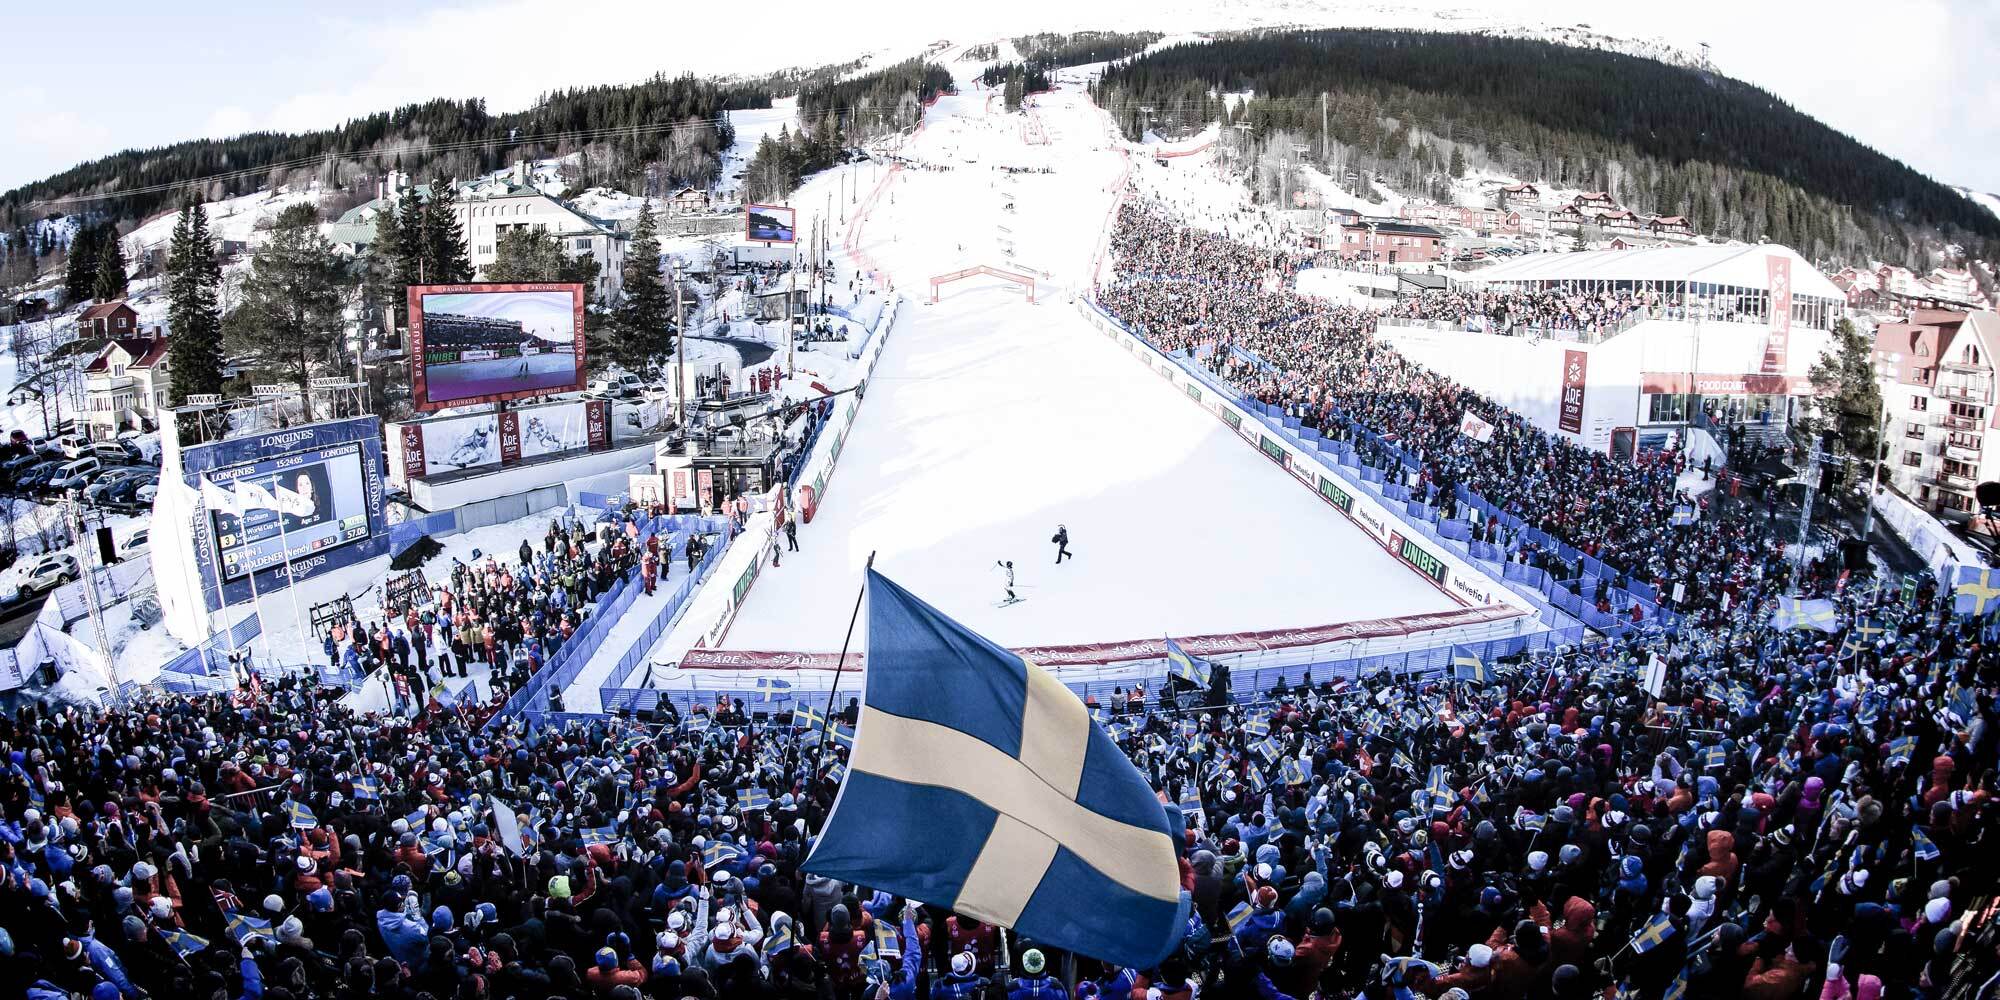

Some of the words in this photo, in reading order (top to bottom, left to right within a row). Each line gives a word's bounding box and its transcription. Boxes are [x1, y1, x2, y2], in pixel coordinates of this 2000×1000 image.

[412, 322, 423, 377] BAUHAUS
[1564, 382, 1582, 406] ÅRE
[1699, 380, 1721, 391] FOOD
[589, 421, 603, 433] ÅRE
[260, 429, 314, 448] LONGINES
[502, 433, 518, 447] ÅRE
[320, 445, 359, 459] LONGINES
[405, 449, 423, 464] ÅRE
[1261, 436, 1284, 461] UNIBET
[276, 456, 303, 468] 15:24:05
[211, 466, 255, 482] LONGINES
[367, 458, 380, 518] LONGINES
[1321, 478, 1350, 510] UNIBET
[221, 520, 228, 530] 3
[1359, 507, 1380, 530] helvetia
[224, 536, 230, 546] 3
[230, 565, 236, 574] 3
[323, 535, 334, 545] SUI
[347, 526, 366, 539] 57.08
[228, 555, 233, 563] 1
[274, 555, 327, 579] LONGINES
[1402, 540, 1443, 579] UNIBET
[1453, 576, 1483, 602] helvetia
[713, 652, 740, 665] ÅRE
